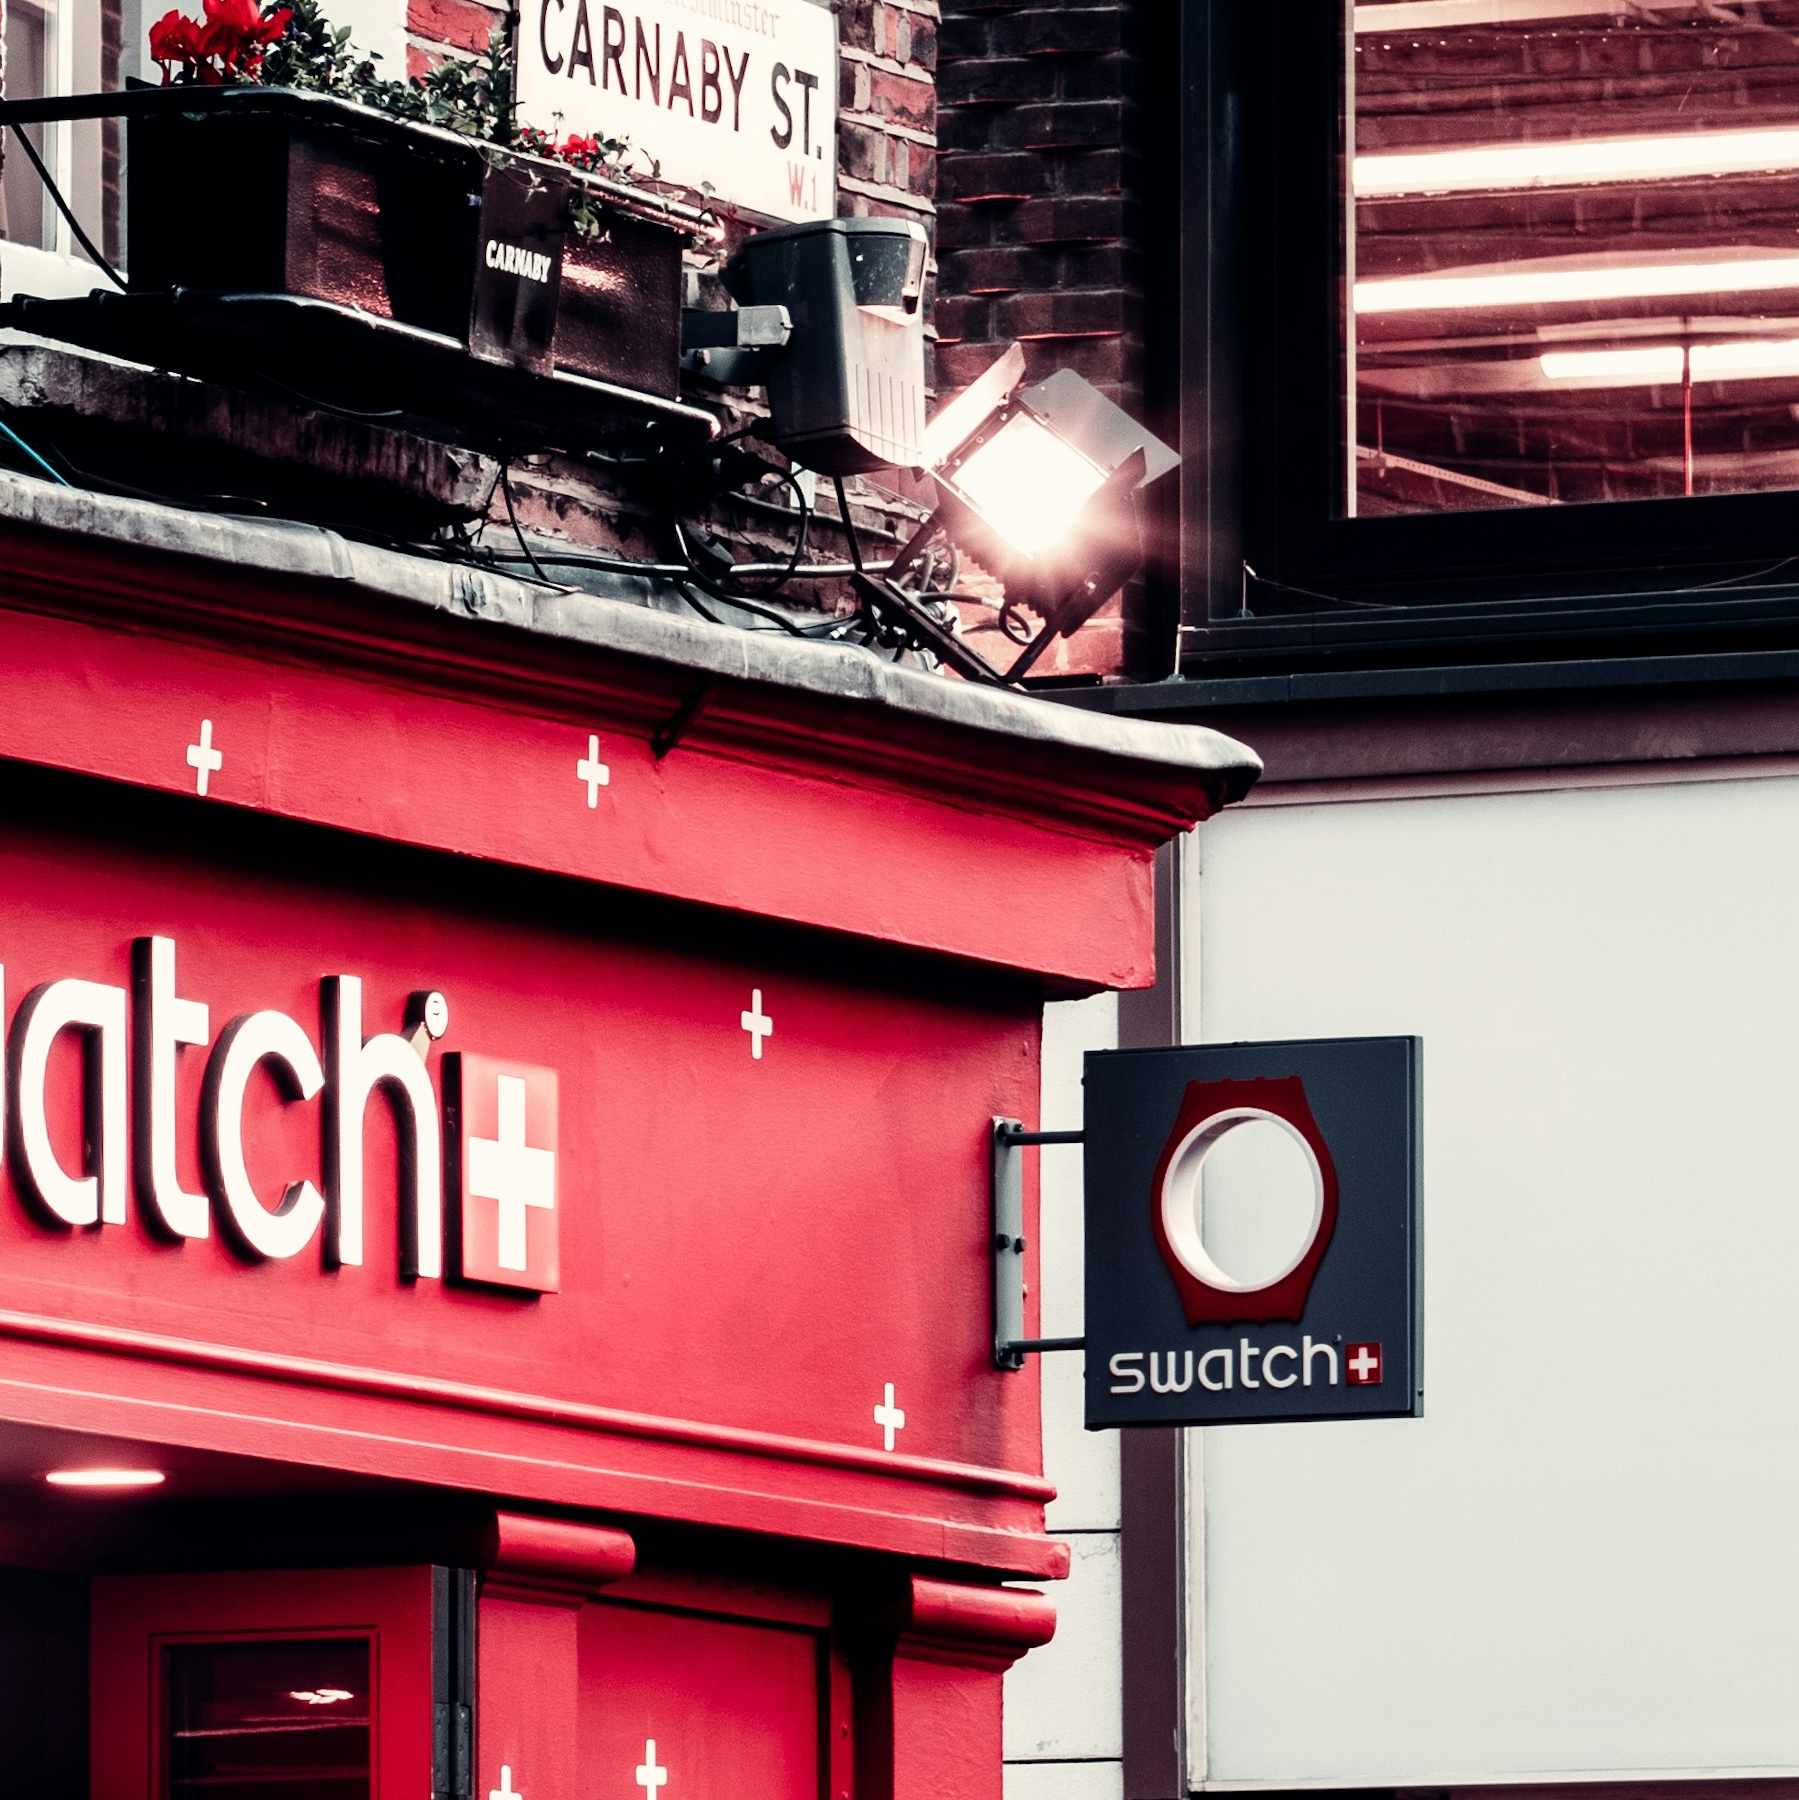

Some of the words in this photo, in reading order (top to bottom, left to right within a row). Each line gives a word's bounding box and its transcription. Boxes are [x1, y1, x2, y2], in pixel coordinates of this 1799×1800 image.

[769, 61, 823, 161] ST.
[787, 160, 818, 214] W.1
[485, 239, 552, 283] CARNABY
[1109, 1334, 1339, 1394] swatch
